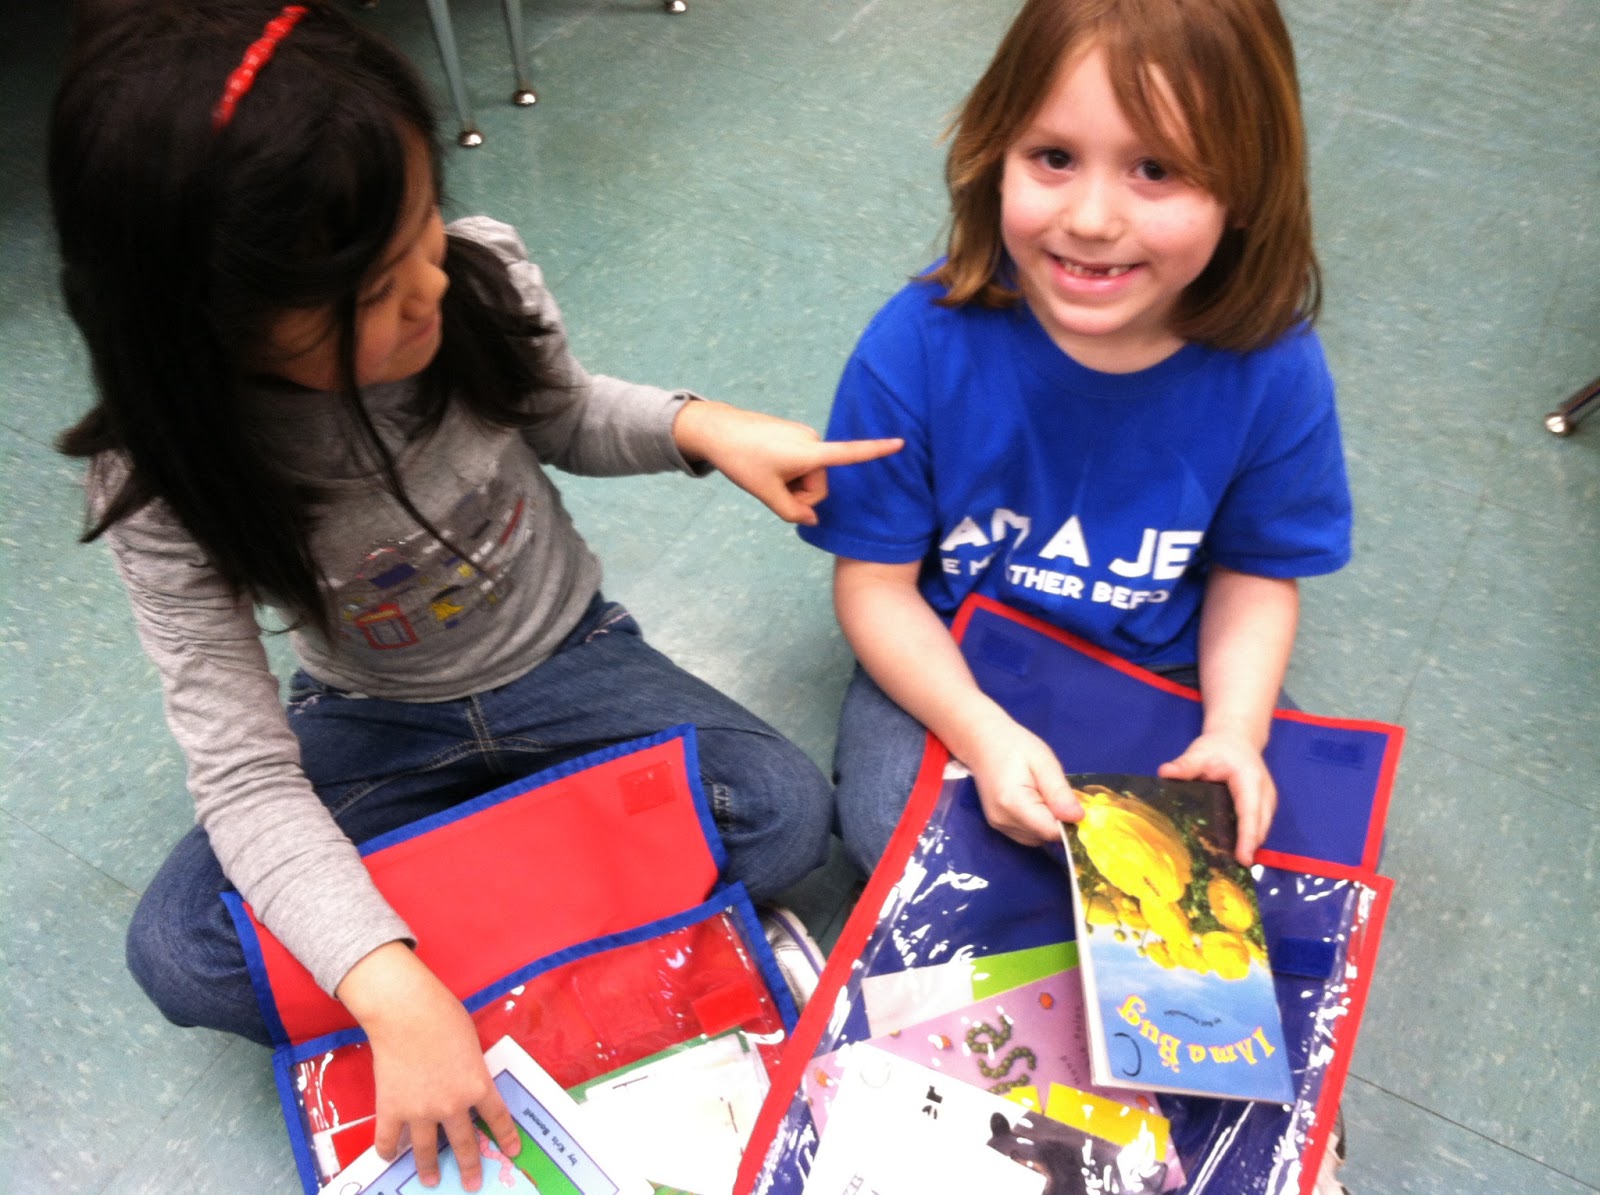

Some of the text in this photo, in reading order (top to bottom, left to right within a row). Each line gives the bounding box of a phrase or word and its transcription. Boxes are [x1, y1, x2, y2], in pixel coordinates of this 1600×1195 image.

[1038, 514, 1091, 567] A
[1117, 994, 1182, 1066] Bug
[1252, 1026, 1276, 1058] I
[1187, 1044, 1207, 1064] a
